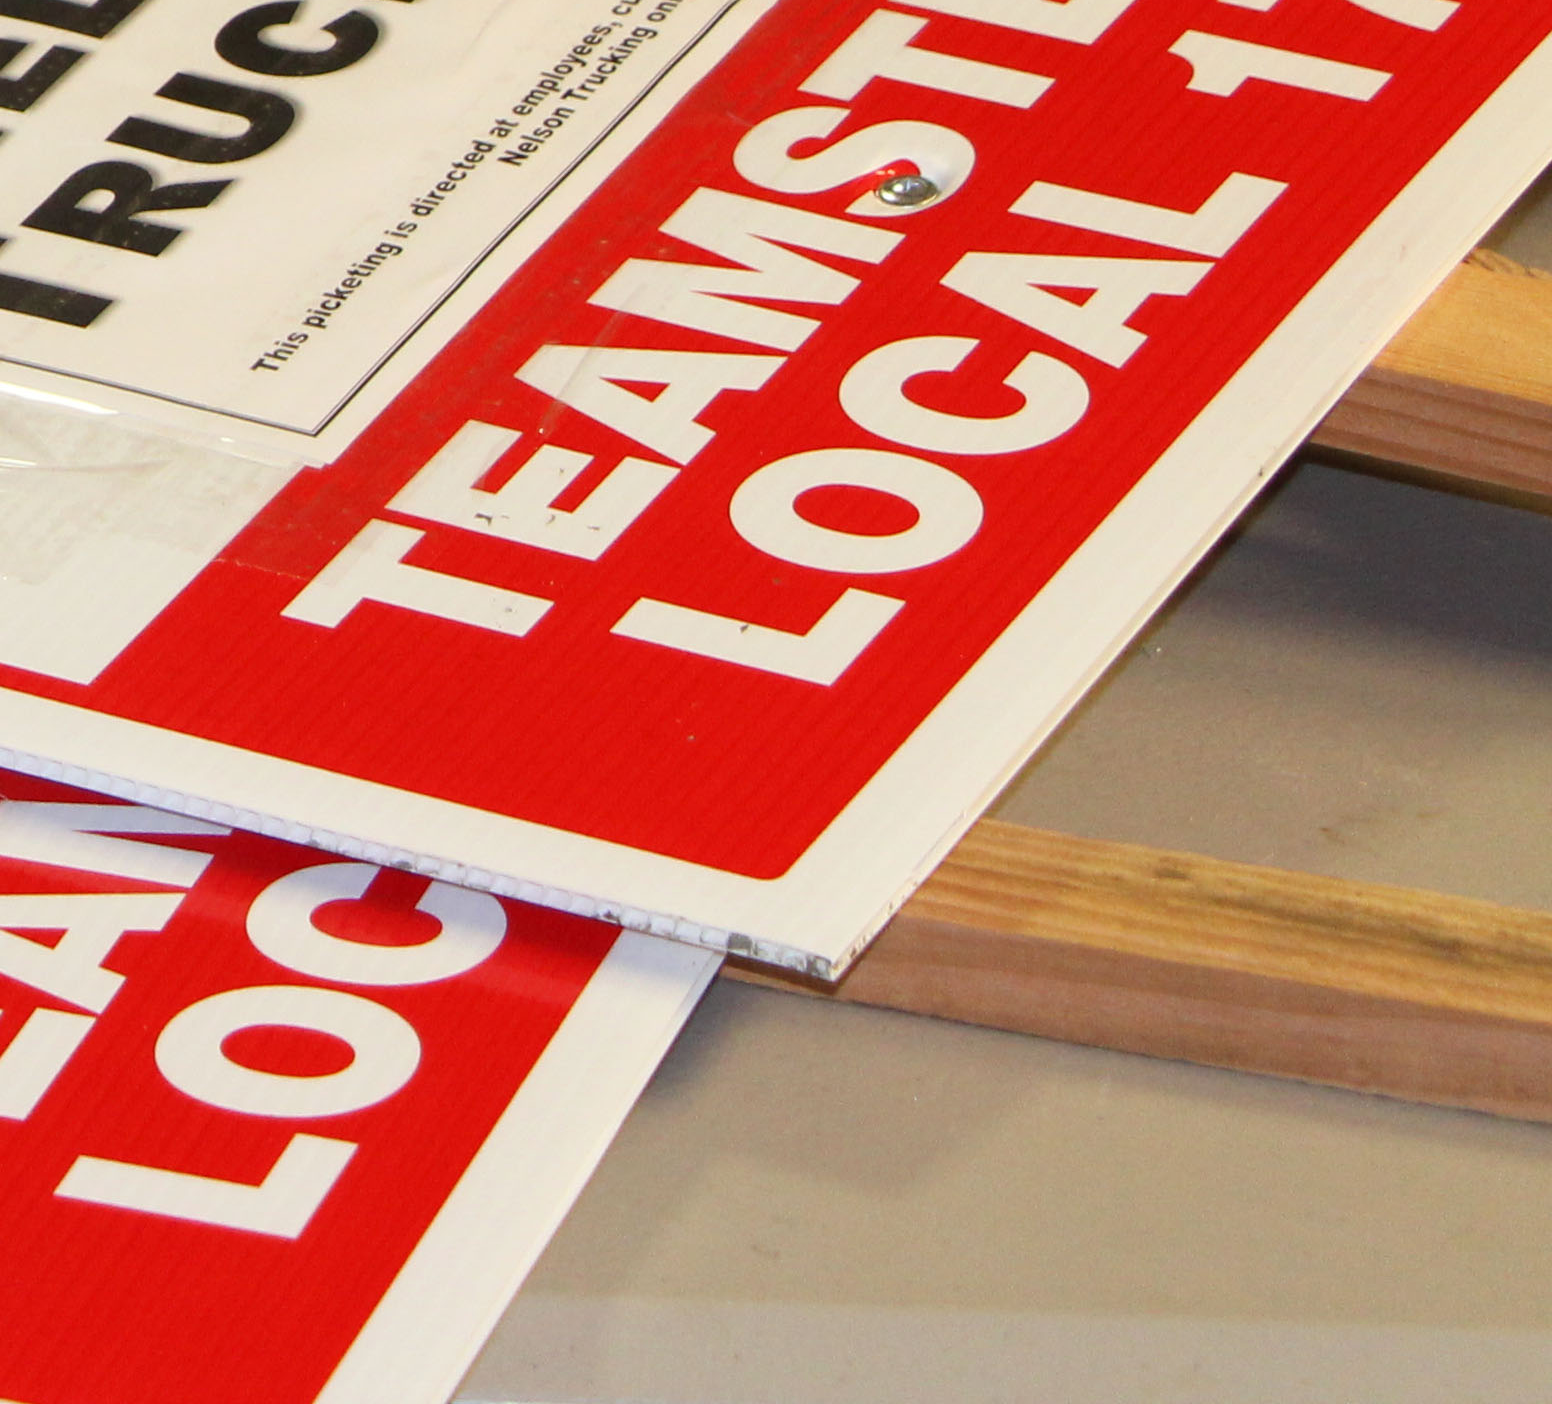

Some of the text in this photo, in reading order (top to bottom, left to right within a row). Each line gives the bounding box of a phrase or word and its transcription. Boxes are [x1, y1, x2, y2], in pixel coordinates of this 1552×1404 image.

[249, 329, 309, 373] This
[301, 239, 405, 330] picketing
[383, 219, 419, 240] is
[409, 137, 498, 218] directed
[488, 118, 520, 143] at
[511, 20, 624, 118] employees,
[495, 104, 577, 169] Nelson
[560, 23, 659, 104] Trucking
[608, 171, 1290, 688] LOCAL
[51, 860, 509, 1240] LOC
